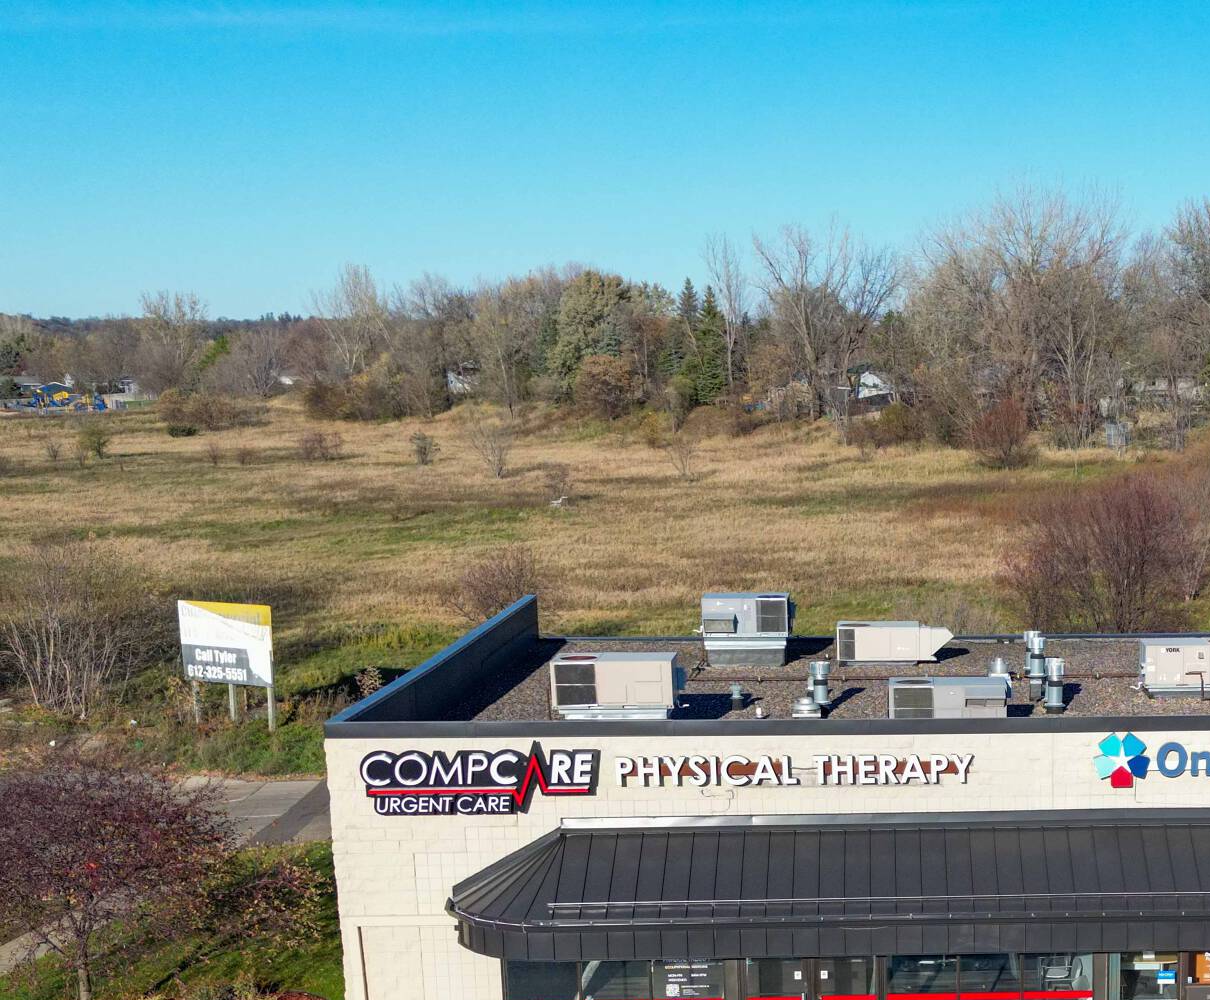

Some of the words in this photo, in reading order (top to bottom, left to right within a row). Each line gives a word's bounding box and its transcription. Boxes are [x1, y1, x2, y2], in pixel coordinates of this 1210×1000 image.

[195, 648, 213, 662] Call
[214, 649, 237, 664] Tyler
[188, 664, 247, 681] 612-325-5551
[361, 751, 594, 788] COMPCARE
[614, 755, 800, 787] PHYSICAL
[813, 754, 975, 785] THERAPY
[376, 796, 453, 813] URGENT
[457, 796, 510, 812] CARE
